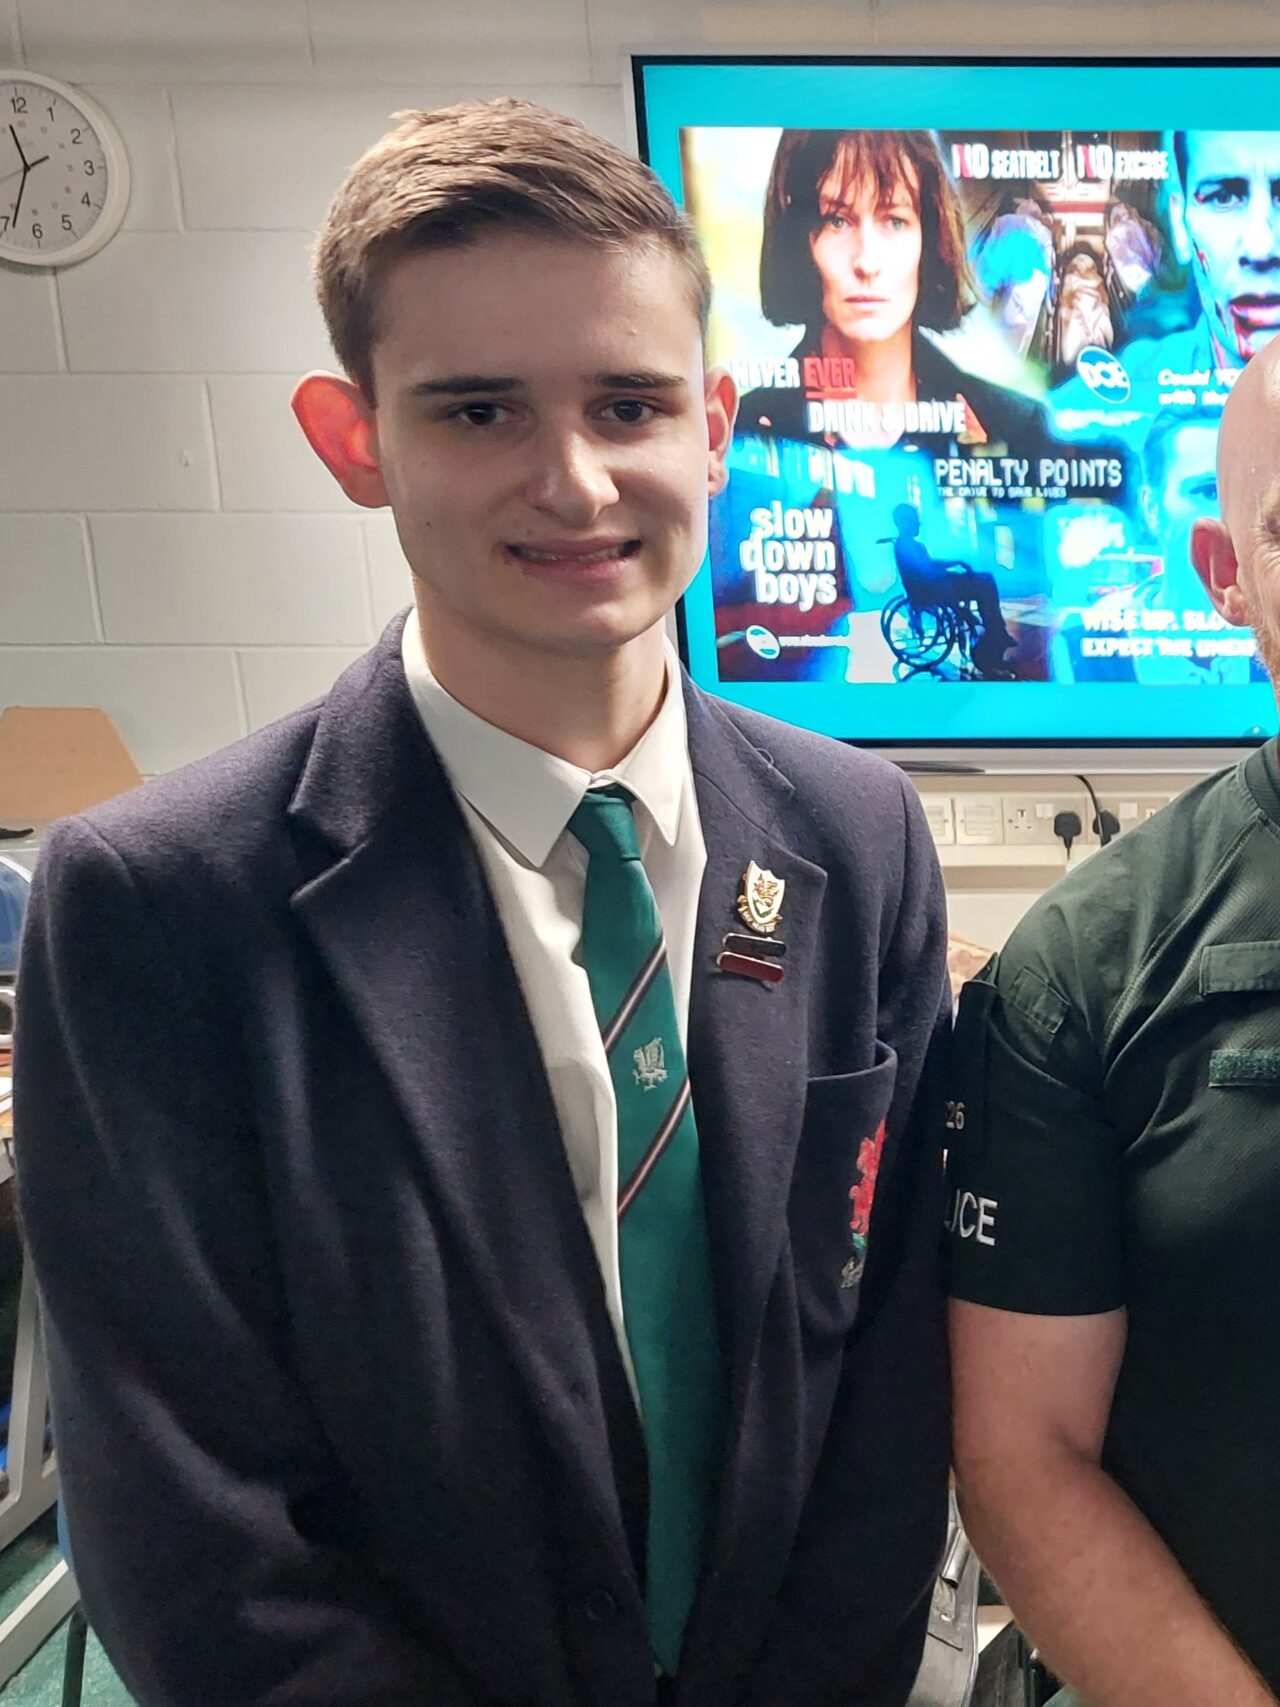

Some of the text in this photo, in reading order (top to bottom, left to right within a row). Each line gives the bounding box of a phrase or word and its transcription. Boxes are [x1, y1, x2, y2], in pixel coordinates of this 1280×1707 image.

[10, 97, 28, 114] 12
[46, 106, 54, 122] 1
[70, 128, 83, 144] 2
[84, 159, 95, 176] 3
[951, 143, 1060, 179] NO SEATBELT
[1076, 144, 1113, 179] NO
[81, 192, 91, 207] 4
[0, 215, 10, 232] 7
[32, 222, 43, 239] 6
[61, 214, 73, 231] 5
[803, 357, 856, 388] EVER
[808, 401, 876, 432] DRINK
[904, 400, 967, 433] DRIVE
[934, 458, 1122, 487] PENALTY POINTS
[750, 500, 833, 540] slow
[739, 528, 836, 572] down
[755, 568, 838, 612] boys
